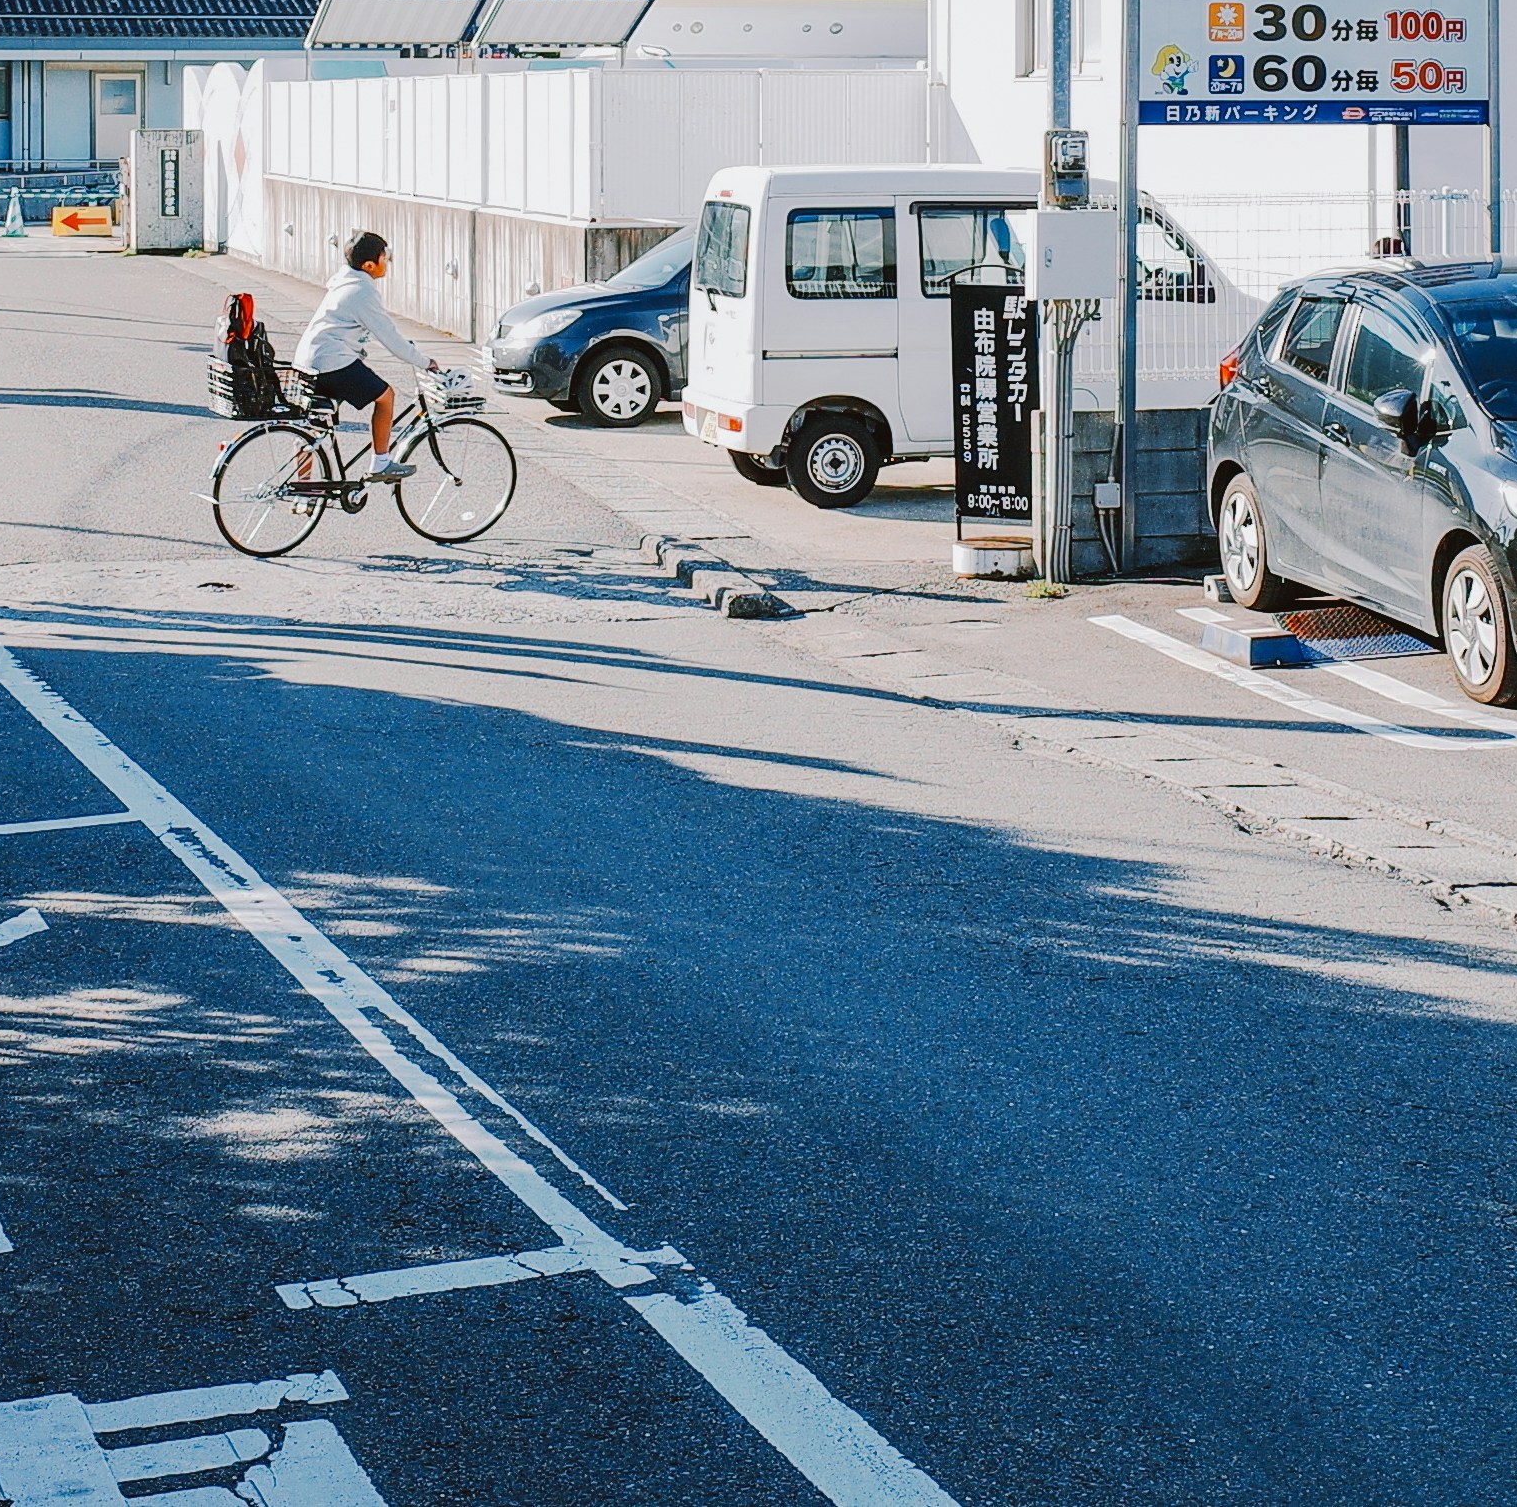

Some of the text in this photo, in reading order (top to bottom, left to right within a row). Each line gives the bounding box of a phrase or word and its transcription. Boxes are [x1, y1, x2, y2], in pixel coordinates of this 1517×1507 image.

[1386, 10, 1467, 42] 100円
[1391, 60, 1467, 93] 50円
[1165, 104, 1319, 122] 日乃新パーキング
[1002, 295, 1029, 423] 駅レンタカー
